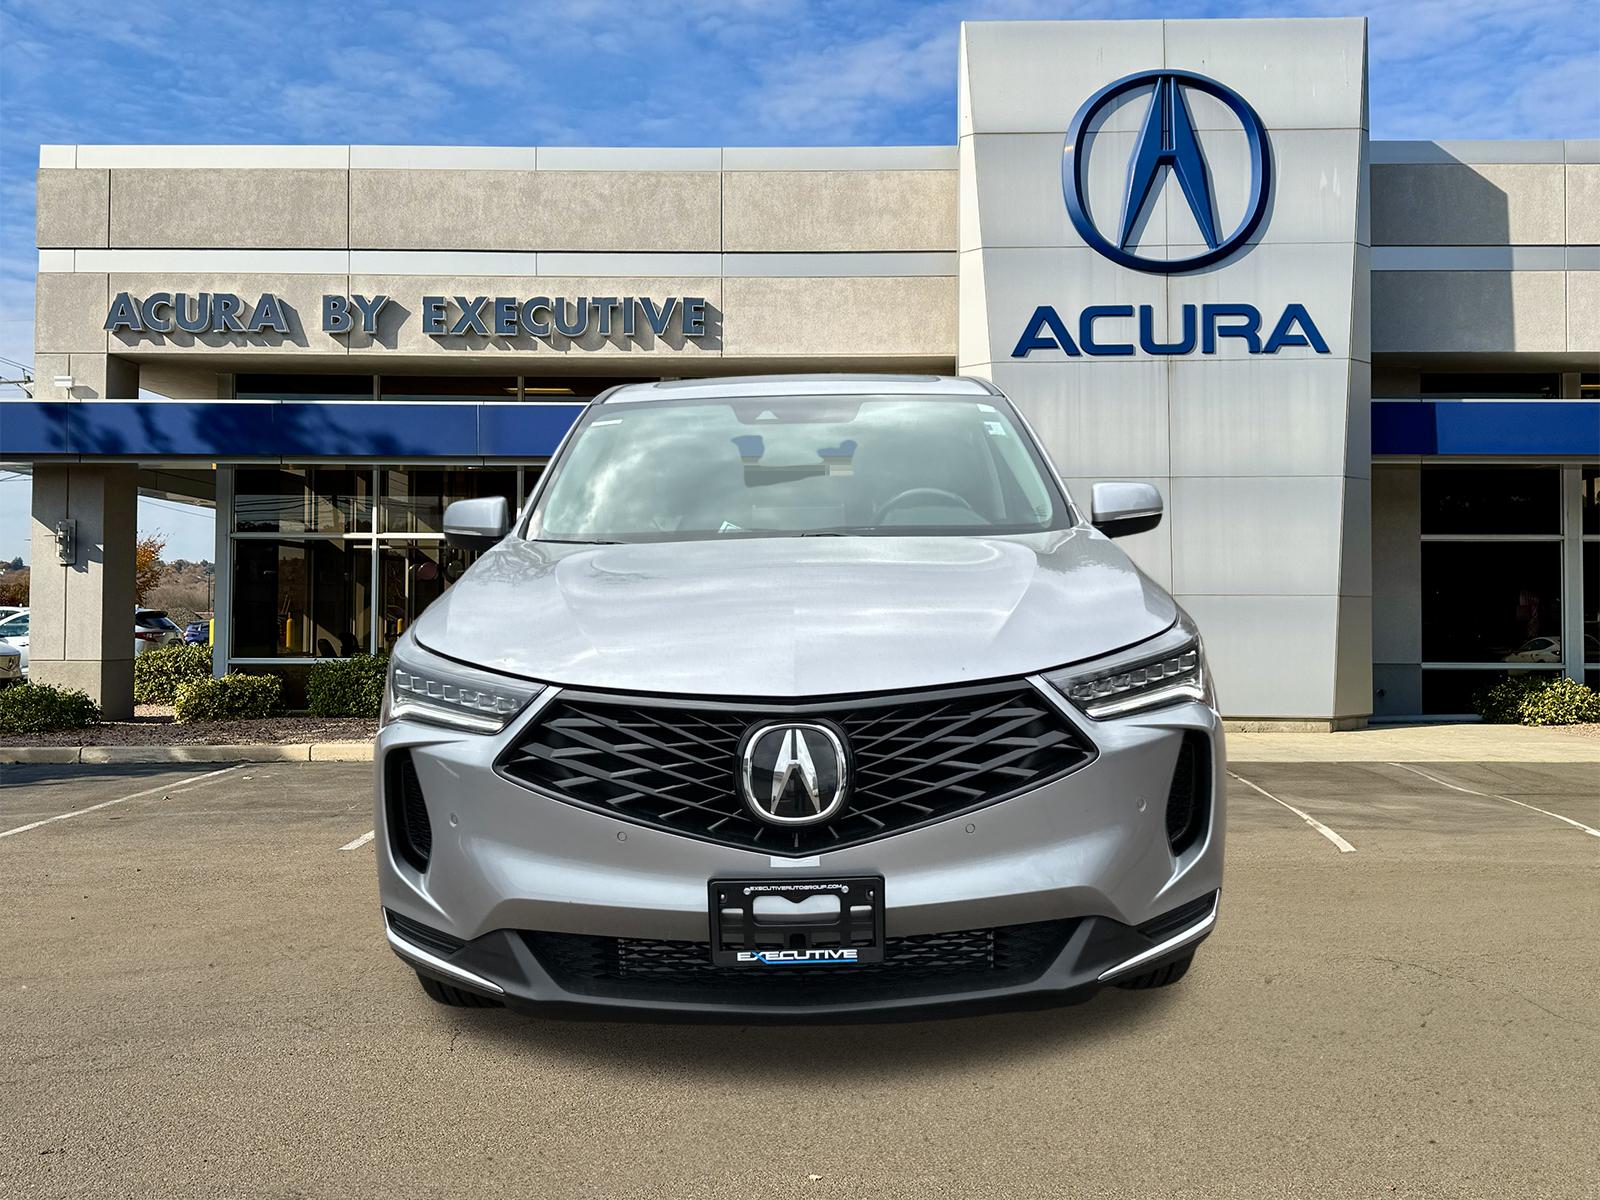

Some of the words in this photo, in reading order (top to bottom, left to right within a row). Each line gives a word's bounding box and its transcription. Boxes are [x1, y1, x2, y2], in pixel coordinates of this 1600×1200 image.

[104, 291, 289, 334] ACURA
[322, 294, 393, 335] BY
[421, 296, 707, 338] EXECUTIVE
[1011, 303, 1332, 357] ACURA
[737, 949, 858, 962] EXECUTIVE
